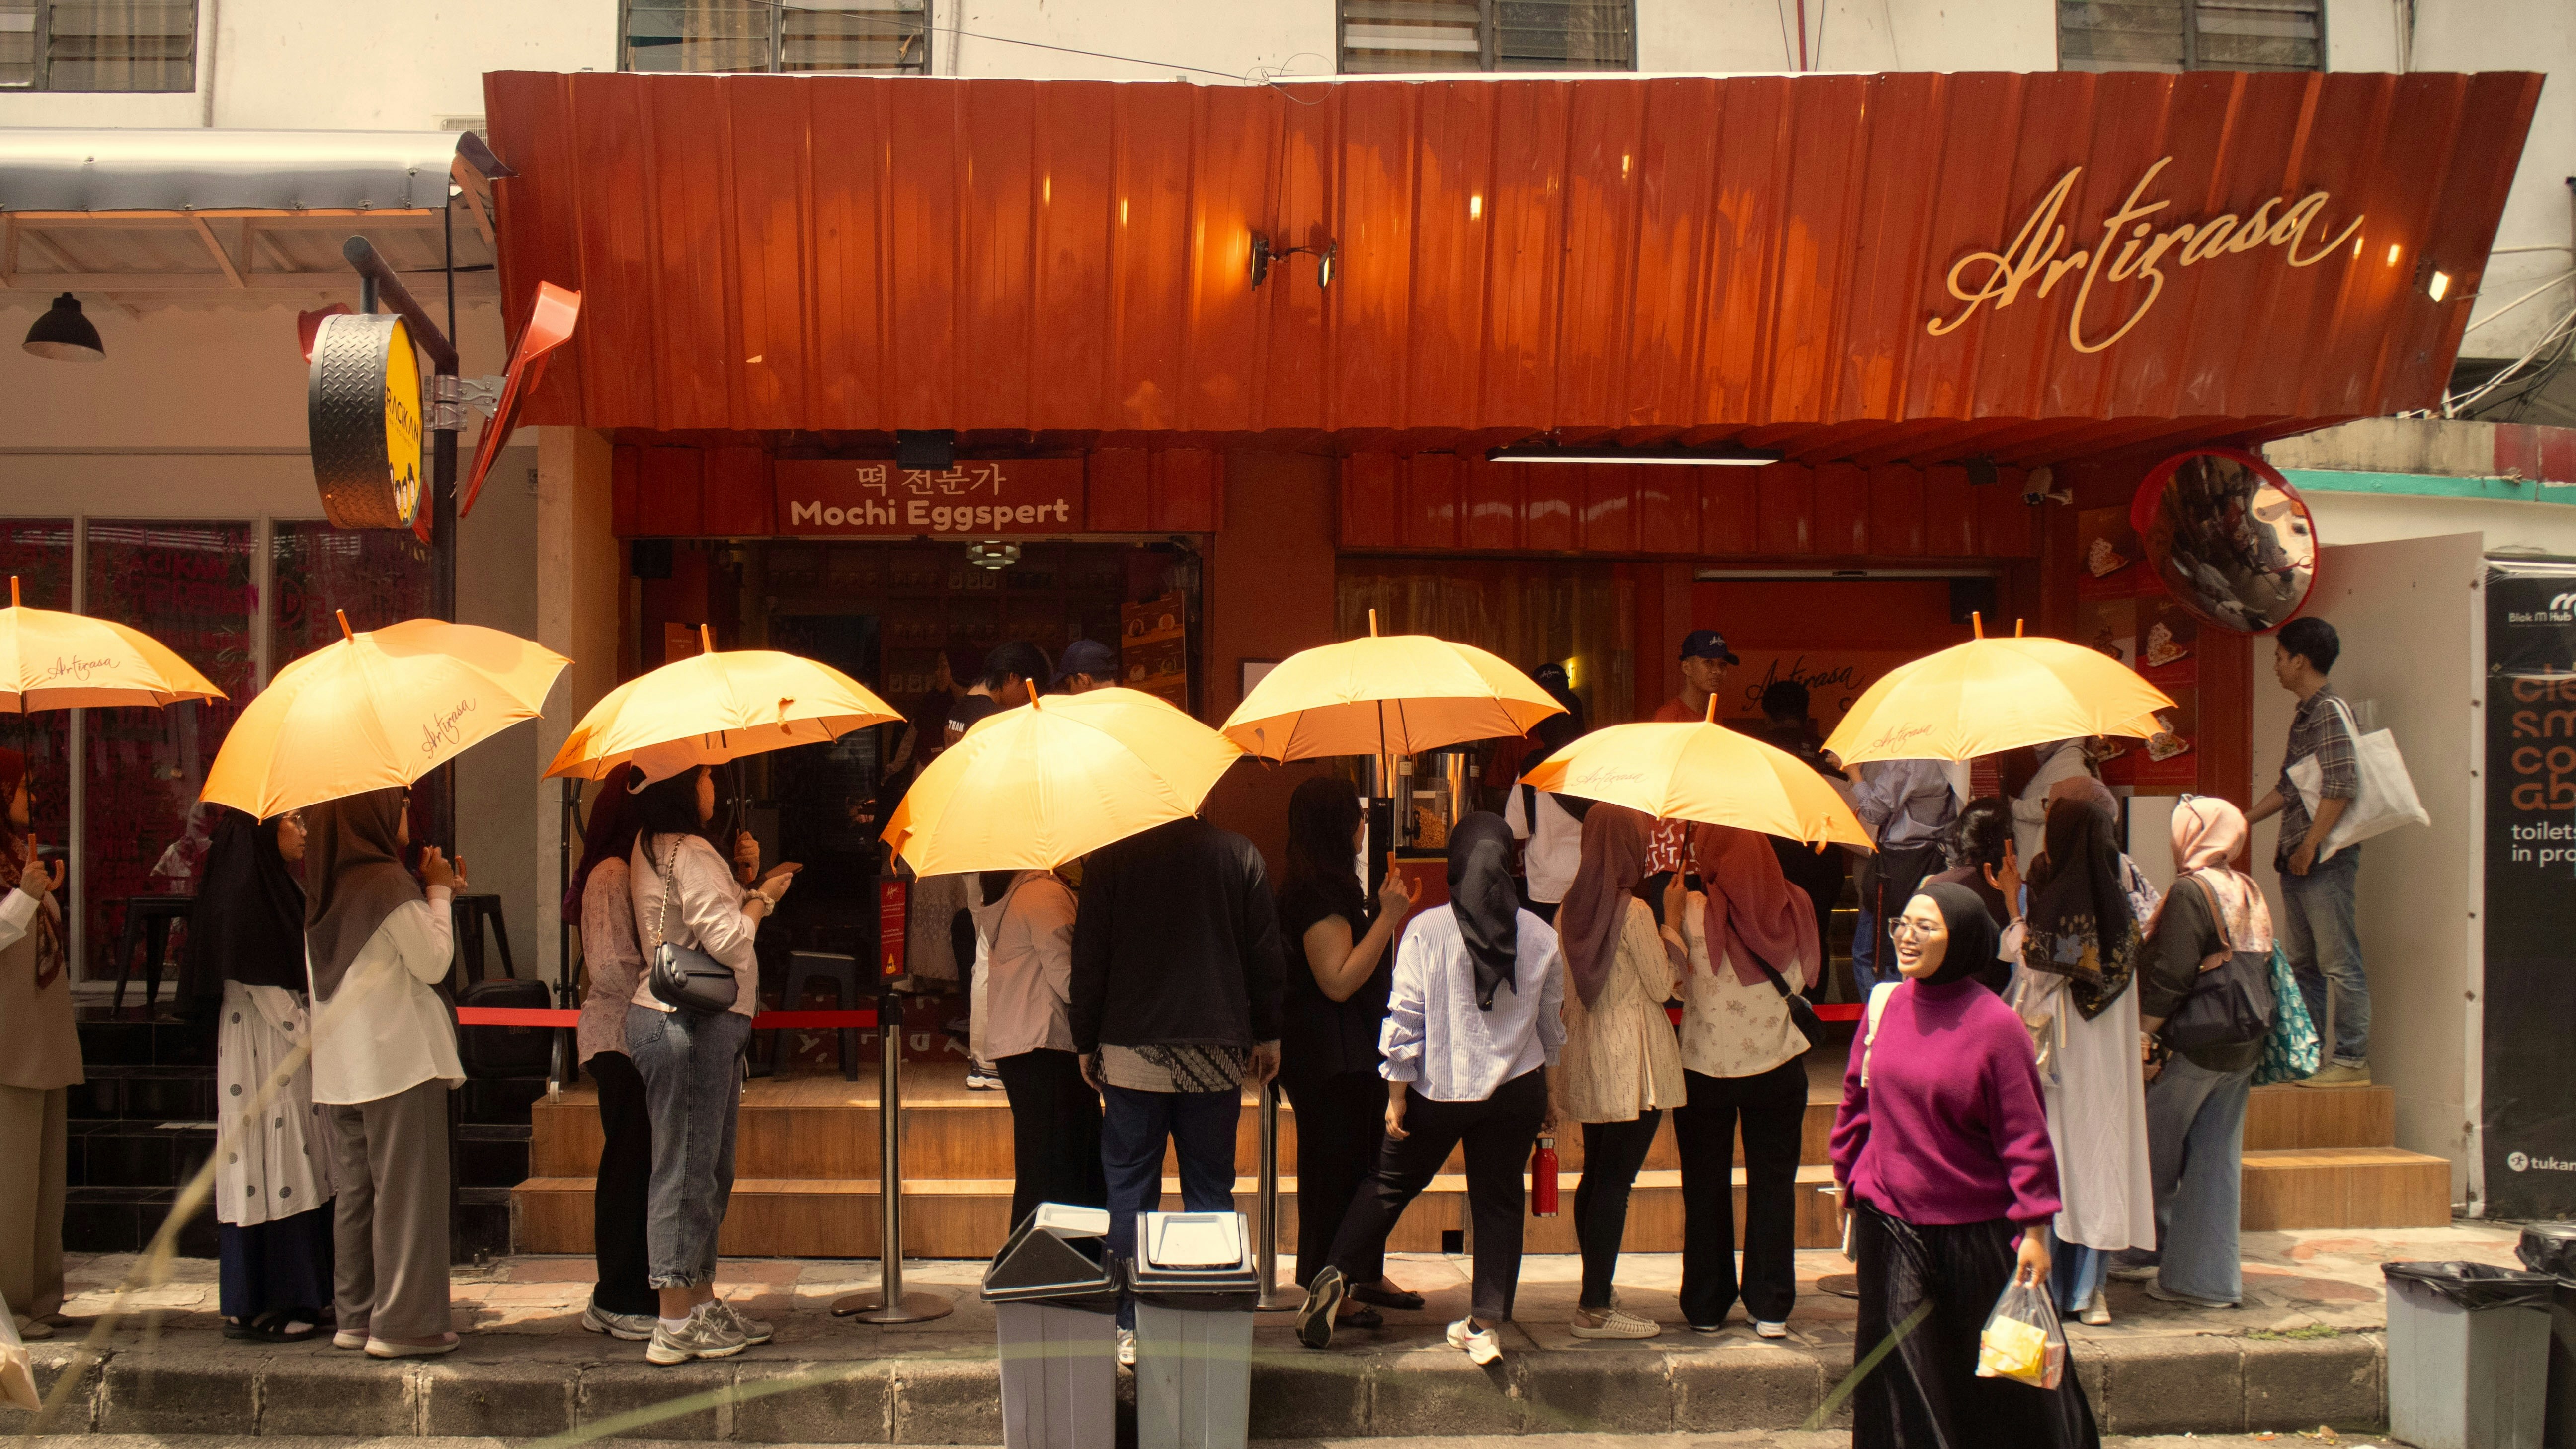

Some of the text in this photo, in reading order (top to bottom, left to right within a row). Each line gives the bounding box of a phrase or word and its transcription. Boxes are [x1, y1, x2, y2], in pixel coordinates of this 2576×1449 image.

[1927, 156, 2364, 353] Artirasa
[856, 463, 1007, 497] 떡 전문가
[790, 498, 1070, 531] Mochi Eggspert
[2509, 612, 2533, 622] Blok
[2549, 612, 2573, 621] Hub
[47, 654, 120, 681] Artirasa
[422, 698, 476, 759] Artirasa
[948, 719, 965, 733] TEAM
[1869, 722, 1937, 754] Artirasa
[2512, 745, 2576, 774] co
[1571, 766, 1647, 792] Artirasa
[2512, 844, 2576, 868] in pro
